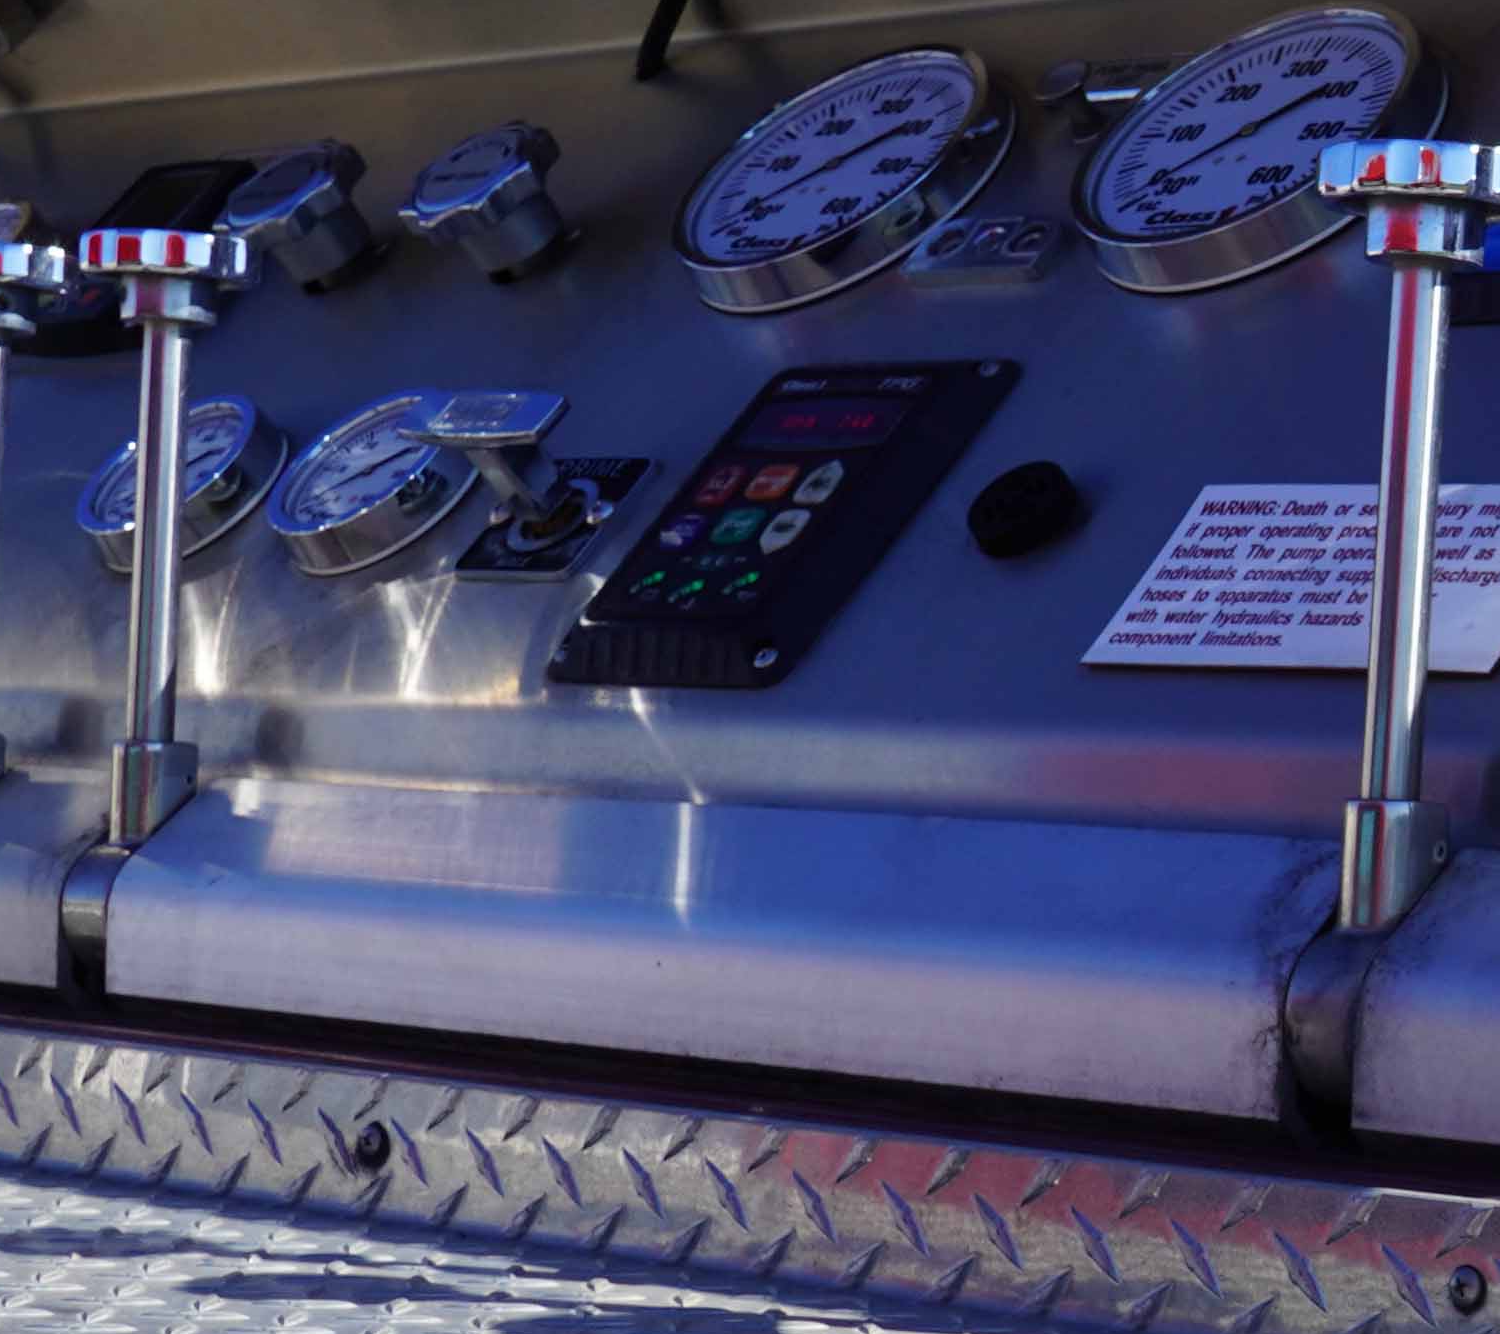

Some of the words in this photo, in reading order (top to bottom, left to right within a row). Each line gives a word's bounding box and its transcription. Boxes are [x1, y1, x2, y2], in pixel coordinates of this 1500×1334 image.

[1282, 59, 1325, 78] 300
[1216, 83, 1262, 102] 200
[873, 97, 914, 115] 300
[817, 117, 855, 136] 200
[1166, 123, 1206, 142] 100
[1298, 121, 1344, 140] 500
[768, 155, 800, 172] 100
[870, 157, 912, 175] 500
[1247, 165, 1293, 185] 600
[820, 197, 861, 216] 600
[1146, 208, 1217, 225] Class
[558, 460, 629, 478] PRIME
[1200, 500, 1280, 516] WARNING:
[1282, 500, 1328, 516] Death
[1334, 503, 1356, 515] or
[1185, 523, 1202, 537] if
[1200, 525, 1254, 541] proper
[1260, 523, 1333, 541] operating
[1435, 526, 1463, 538] are
[1470, 525, 1500, 538] not
[1171, 544, 1238, 559] followed.
[1246, 544, 1275, 559] The
[1278, 547, 1326, 563] pump
[1435, 545, 1472, 559] well
[1474, 547, 1497, 560] as
[1155, 565, 1238, 580] individuals
[1243, 566, 1331, 586] connecting
[1140, 588, 1187, 602] hoses
[1192, 588, 1209, 602] to
[1214, 589, 1293, 606] apparatus
[1297, 589, 1342, 604] must
[1347, 589, 1368, 604] be
[1125, 608, 1158, 623] with
[1164, 610, 1208, 623] water
[1212, 609, 1295, 627] hydraulics
[1299, 610, 1363, 626] hazards
[1109, 632, 1197, 647] component
[1199, 630, 1282, 647] limitations.
